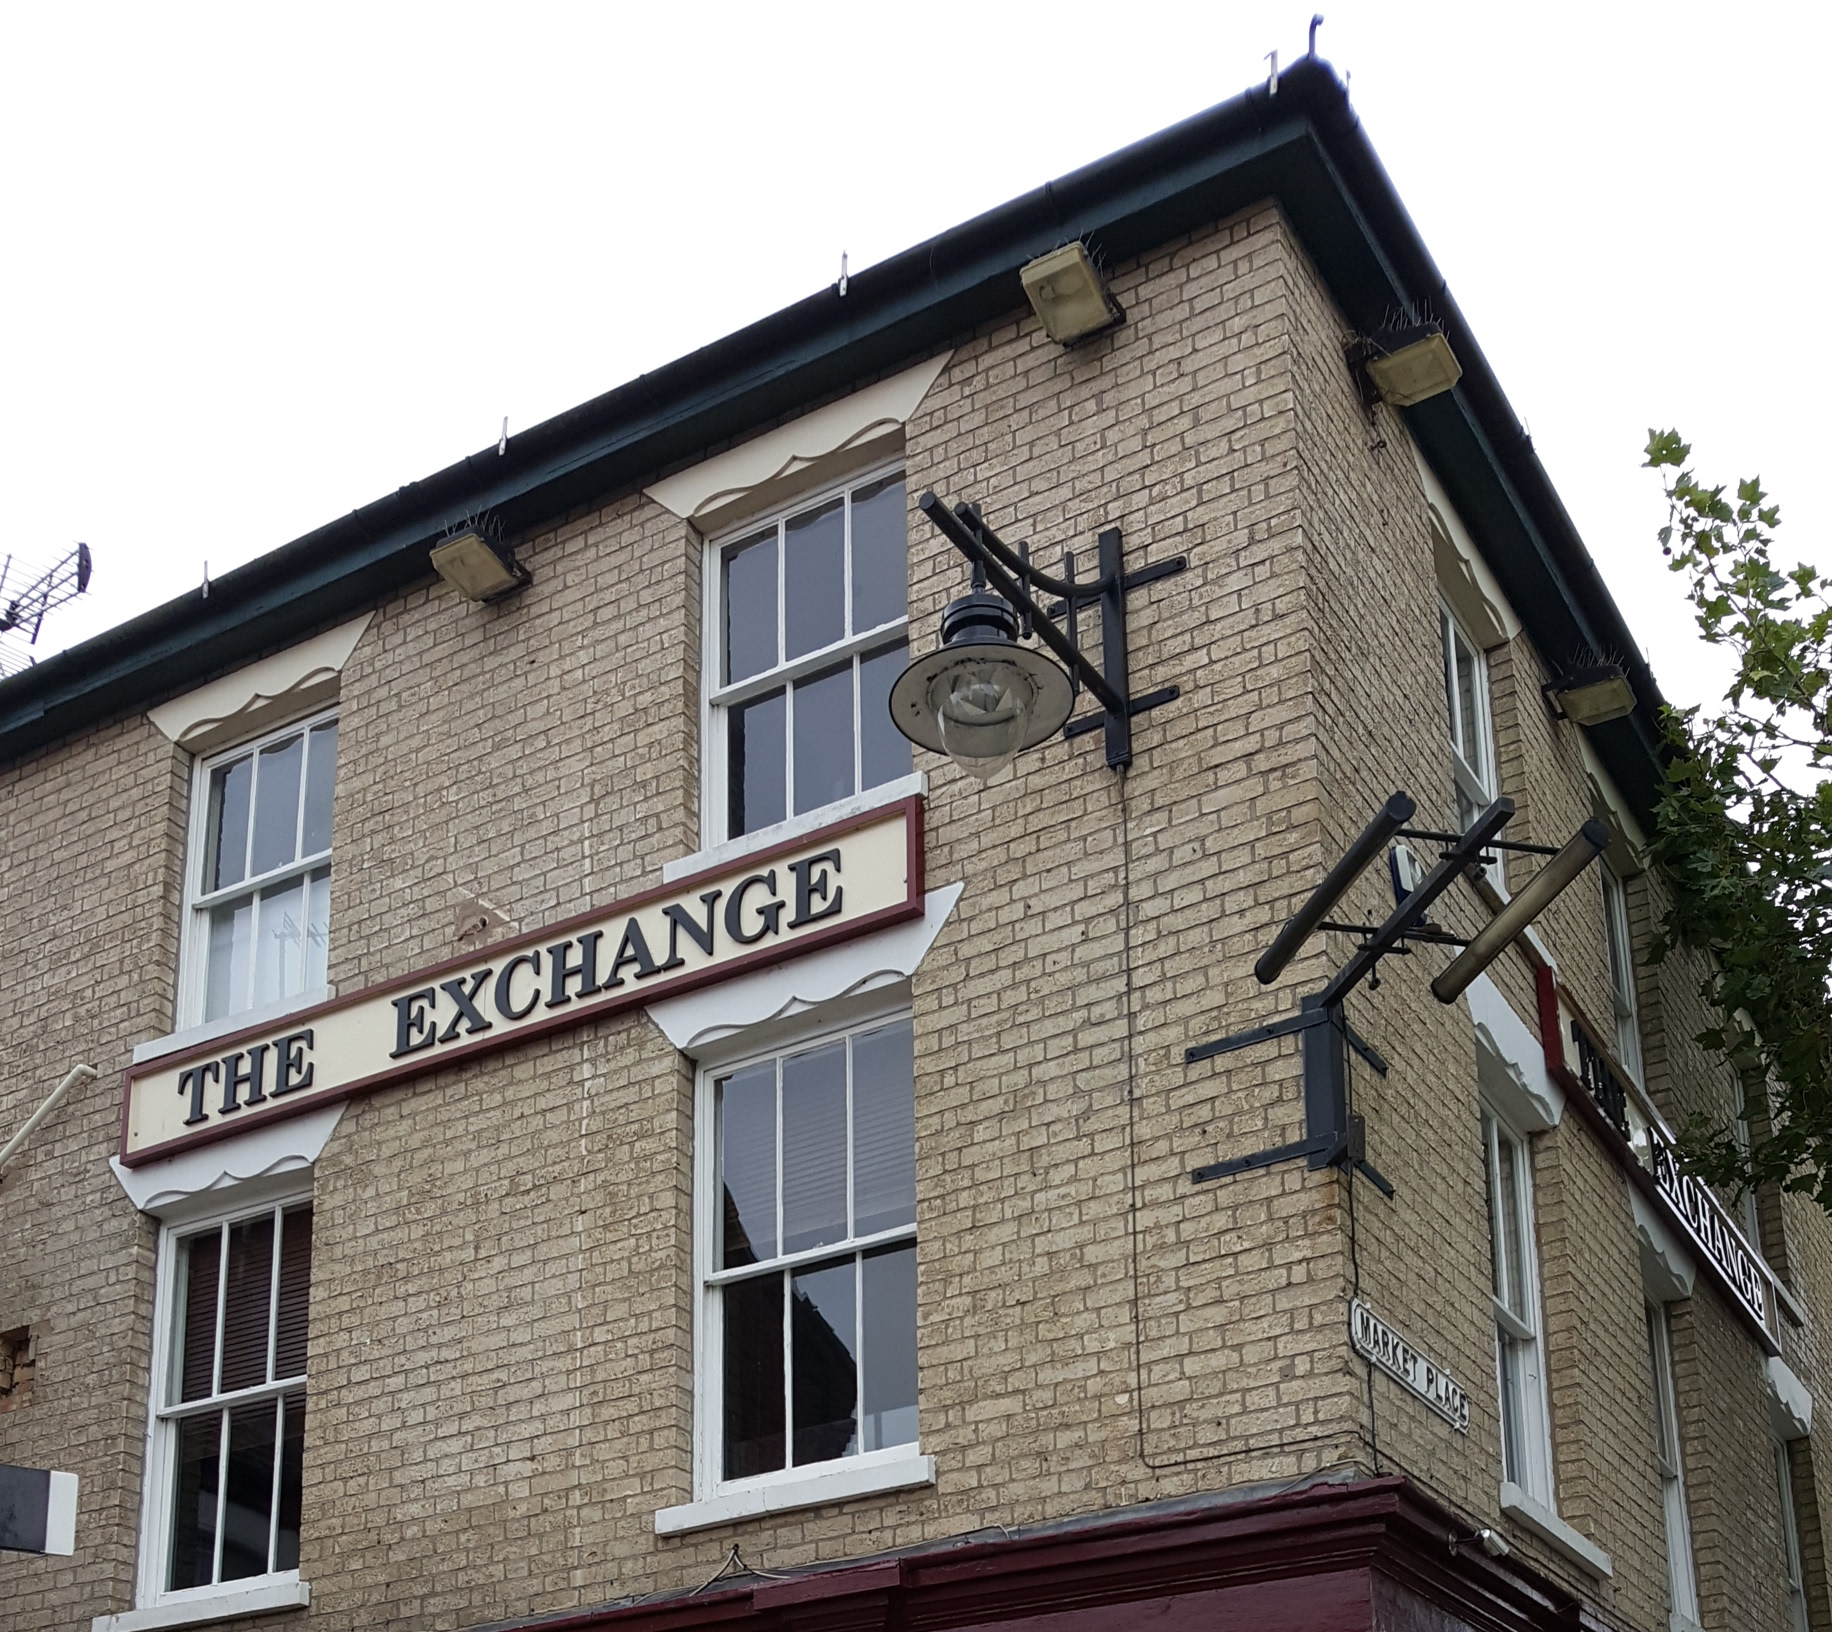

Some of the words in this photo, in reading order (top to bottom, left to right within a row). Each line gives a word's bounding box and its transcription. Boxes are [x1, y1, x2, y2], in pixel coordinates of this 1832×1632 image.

[178, 1028, 314, 1125] THE
[389, 848, 843, 1059] EXCHANGE
[1360, 1311, 1418, 1383] MARKET
[1425, 1365, 1467, 1421] PLACE
